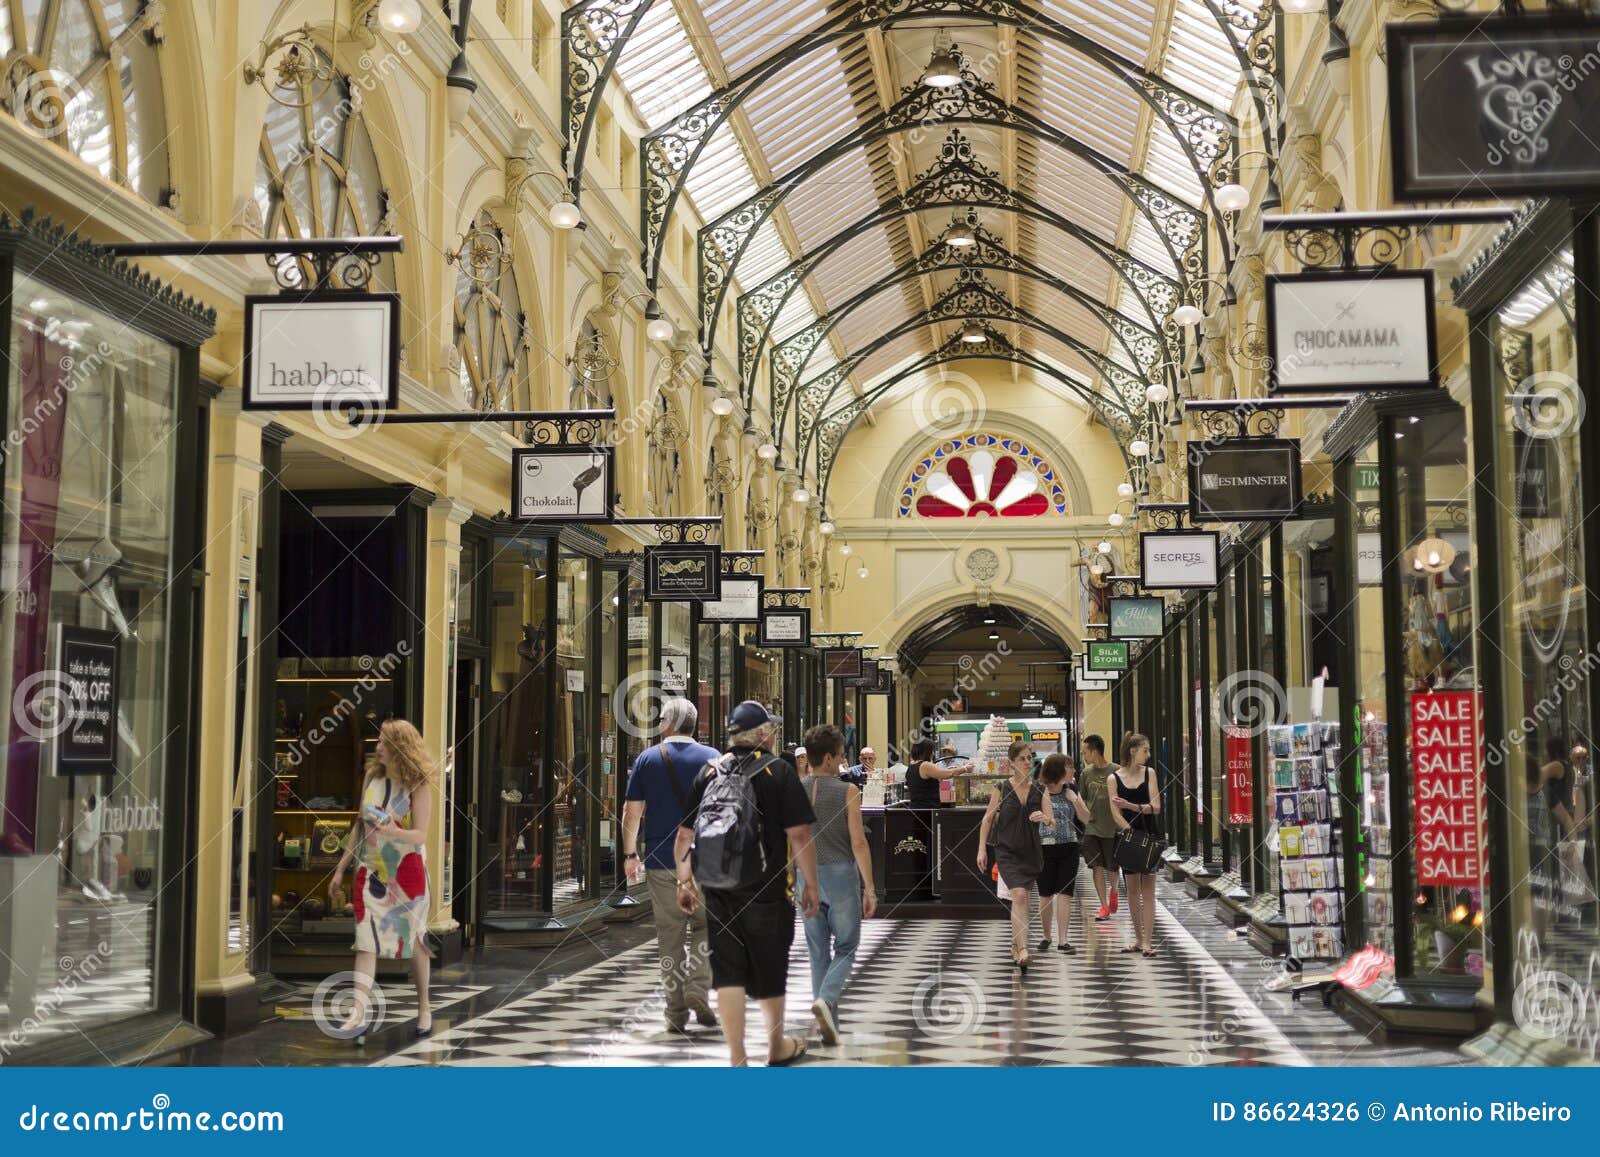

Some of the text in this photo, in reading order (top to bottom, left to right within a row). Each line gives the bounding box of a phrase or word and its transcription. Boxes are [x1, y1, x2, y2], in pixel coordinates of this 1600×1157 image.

[1464, 50, 1556, 88] Love
[1294, 328, 1400, 348] CHOCAMAMA
[1202, 474, 1288, 490] WESTMINSTER
[1153, 552, 1201, 562] SECRETS
[1098, 648, 1119, 656] SILK
[68, 680, 111, 701] 20% OFF
[1416, 700, 1471, 721] SALE
[1417, 726, 1473, 747] SALE
[1418, 752, 1474, 773] SALE
[1419, 779, 1475, 800] SALE
[1420, 805, 1476, 826] SALE
[1421, 831, 1477, 852] SALE
[1422, 858, 1478, 879] SALE
